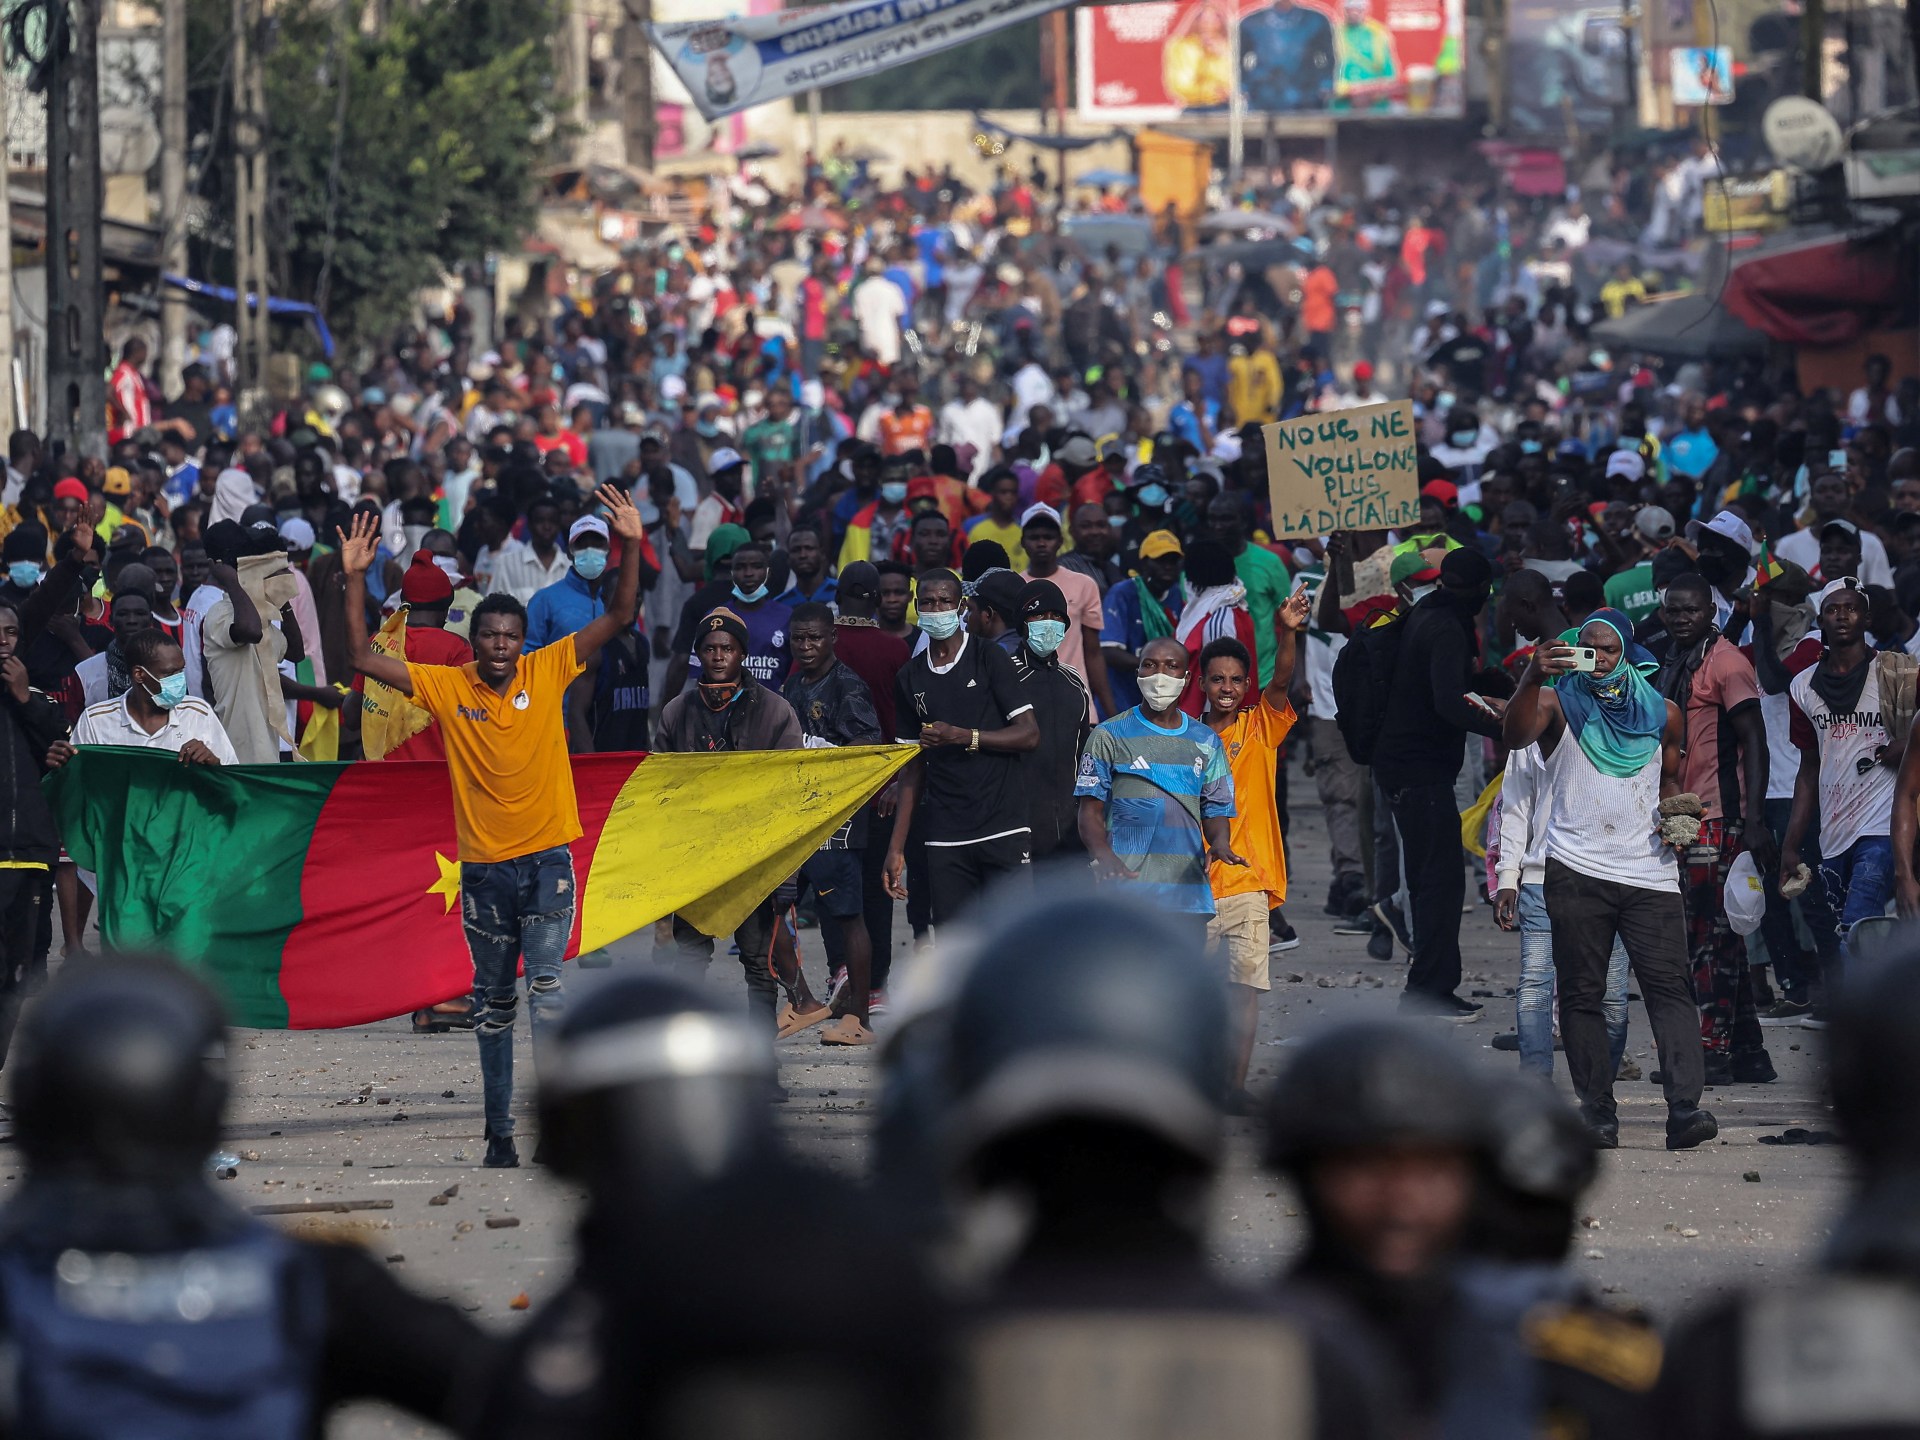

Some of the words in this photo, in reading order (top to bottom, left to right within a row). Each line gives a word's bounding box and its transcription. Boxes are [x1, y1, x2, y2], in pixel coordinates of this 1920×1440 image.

[780, 3, 896, 54] Perpétue
[1279, 418, 1358, 450] NOUS
[1371, 411, 1409, 439] NE
[1293, 445, 1418, 479] VOULONS
[1324, 474, 1381, 503] PLUS
[456, 704, 489, 722] PSNC
[1830, 723, 1858, 740] 2025
